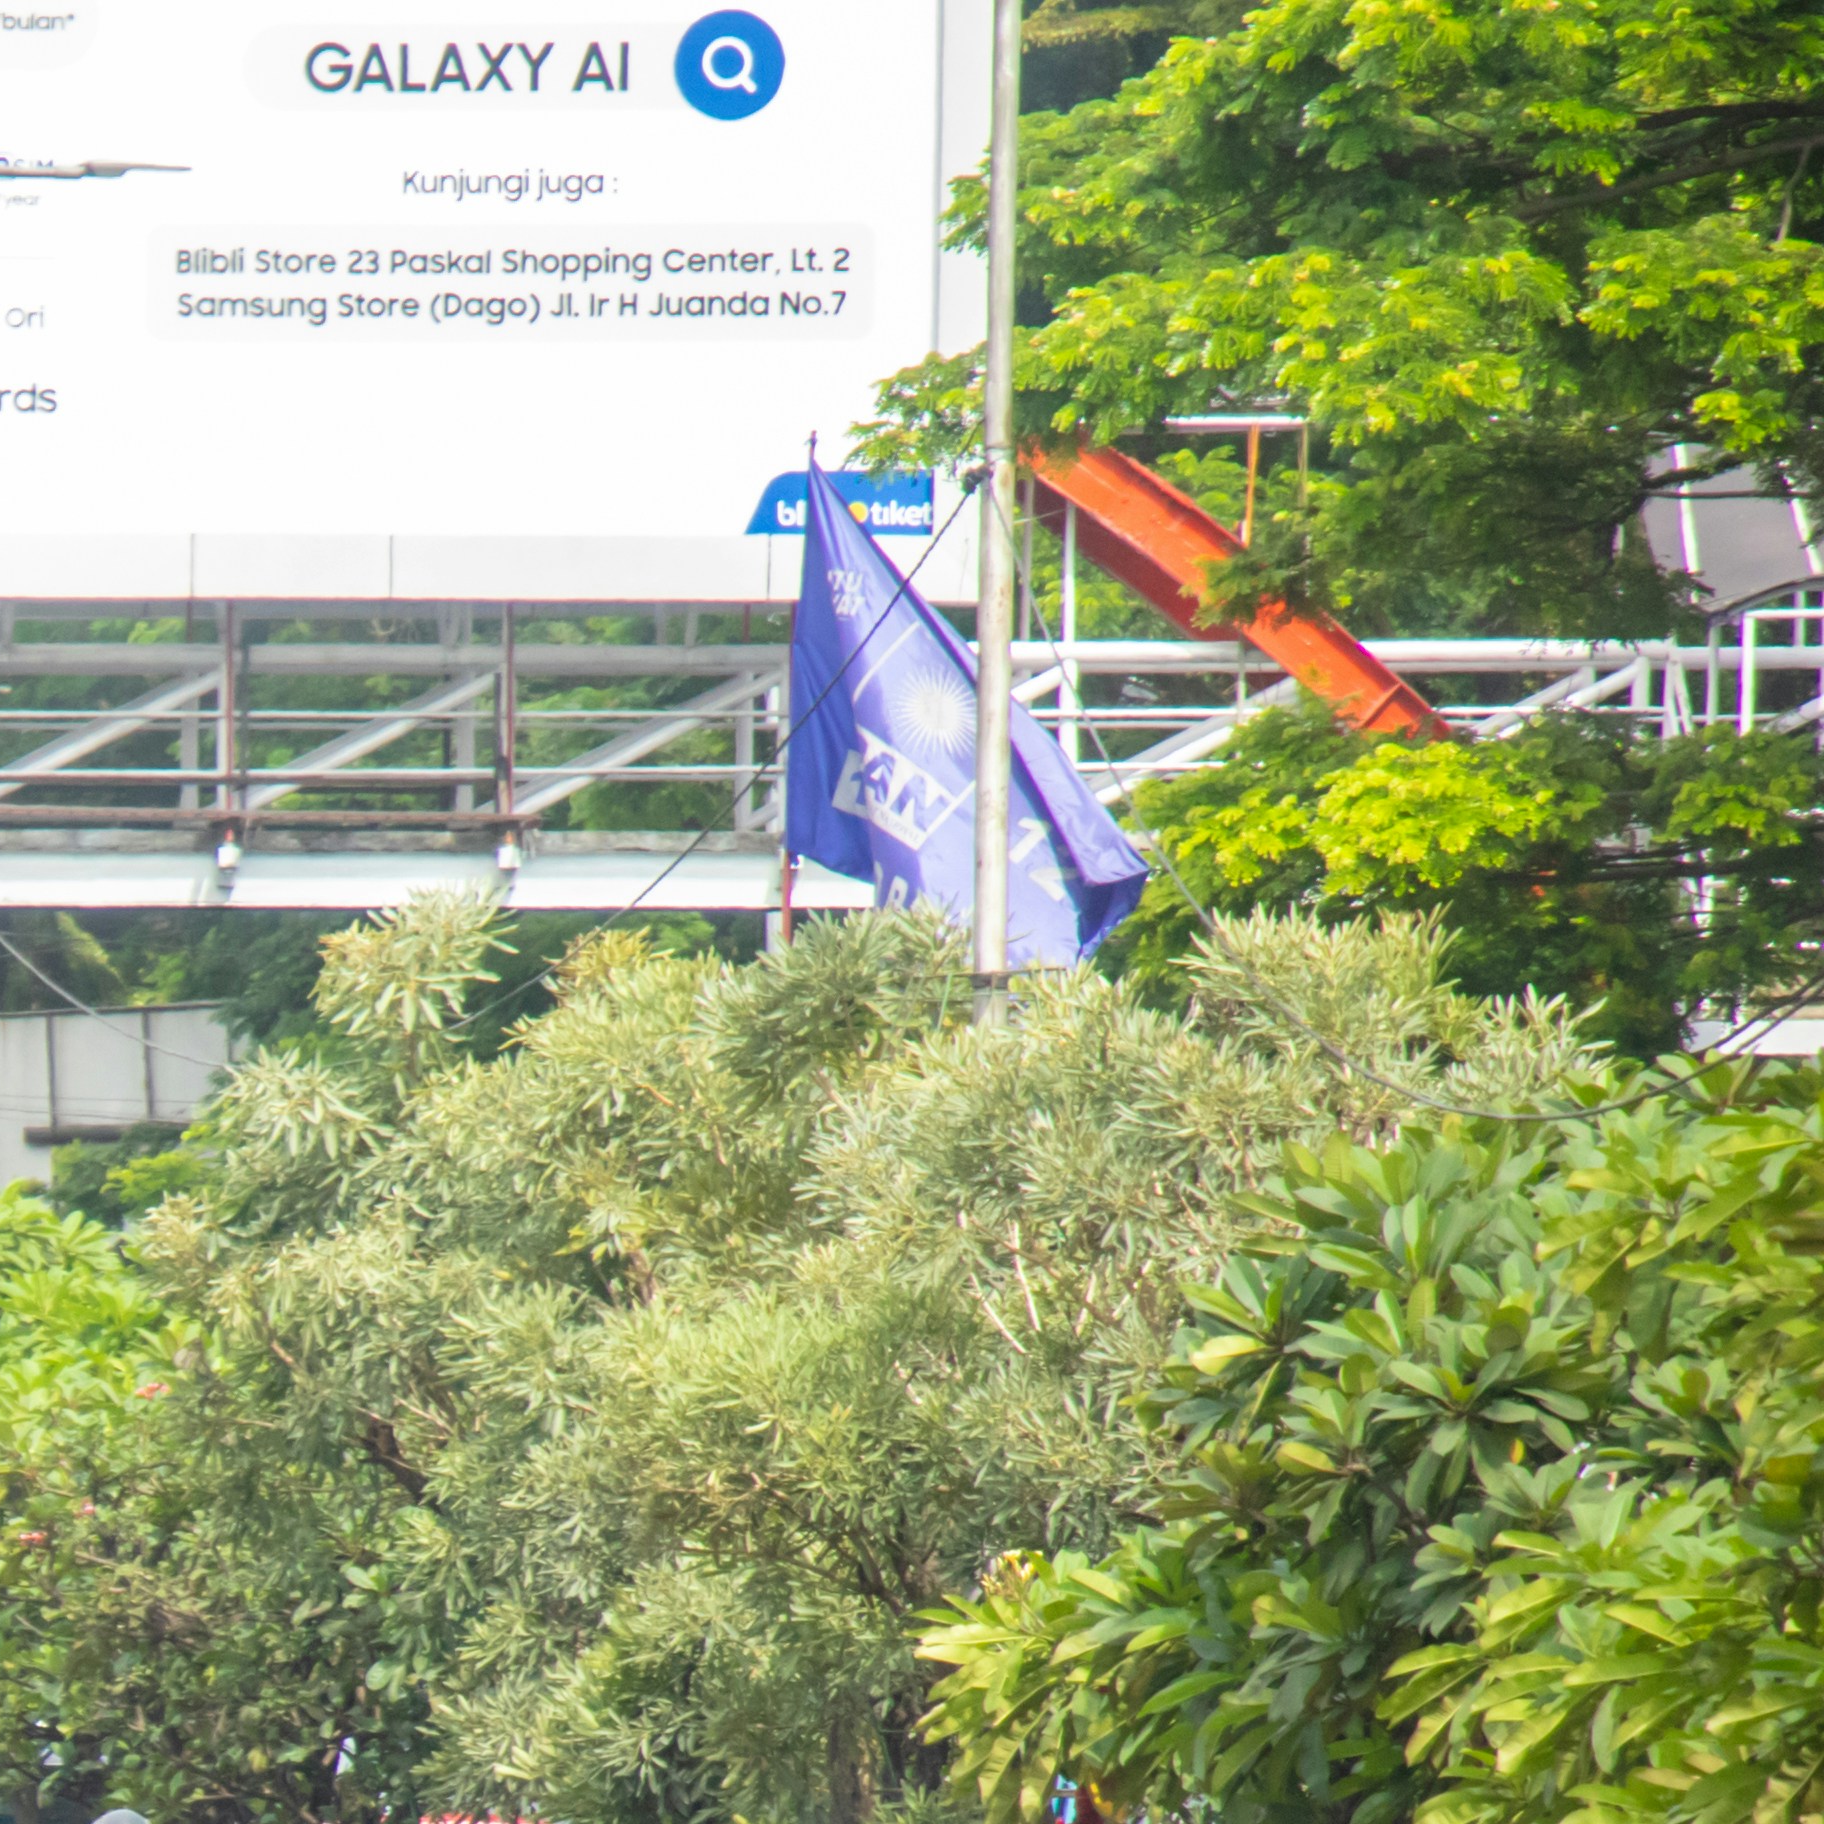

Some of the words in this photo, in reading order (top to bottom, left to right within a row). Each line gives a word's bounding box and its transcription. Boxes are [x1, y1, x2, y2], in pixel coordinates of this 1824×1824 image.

[303, 41, 555, 95] GALAXY
[571, 41, 630, 93] AI
[403, 168, 530, 203] Kunjungi
[535, 168, 604, 204] juga
[175, 247, 245, 275] Blibli
[254, 249, 338, 275] Store
[347, 249, 380, 276] 23
[389, 249, 492, 275] Paskal
[501, 246, 653, 284] Shopping
[661, 248, 781, 276] Center,
[790, 247, 824, 273] Lt.
[832, 247, 850, 274] 2
[5, 306, 44, 329] Ori
[177, 293, 328, 328] Samsung
[337, 293, 421, 319] Store
[429, 292, 541, 327] (Dago)
[589, 293, 610, 318] Ir
[618, 292, 638, 317] H
[648, 291, 770, 318] Juanda
[779, 290, 847, 316] No.7
[870, 500, 932, 526] tiket
